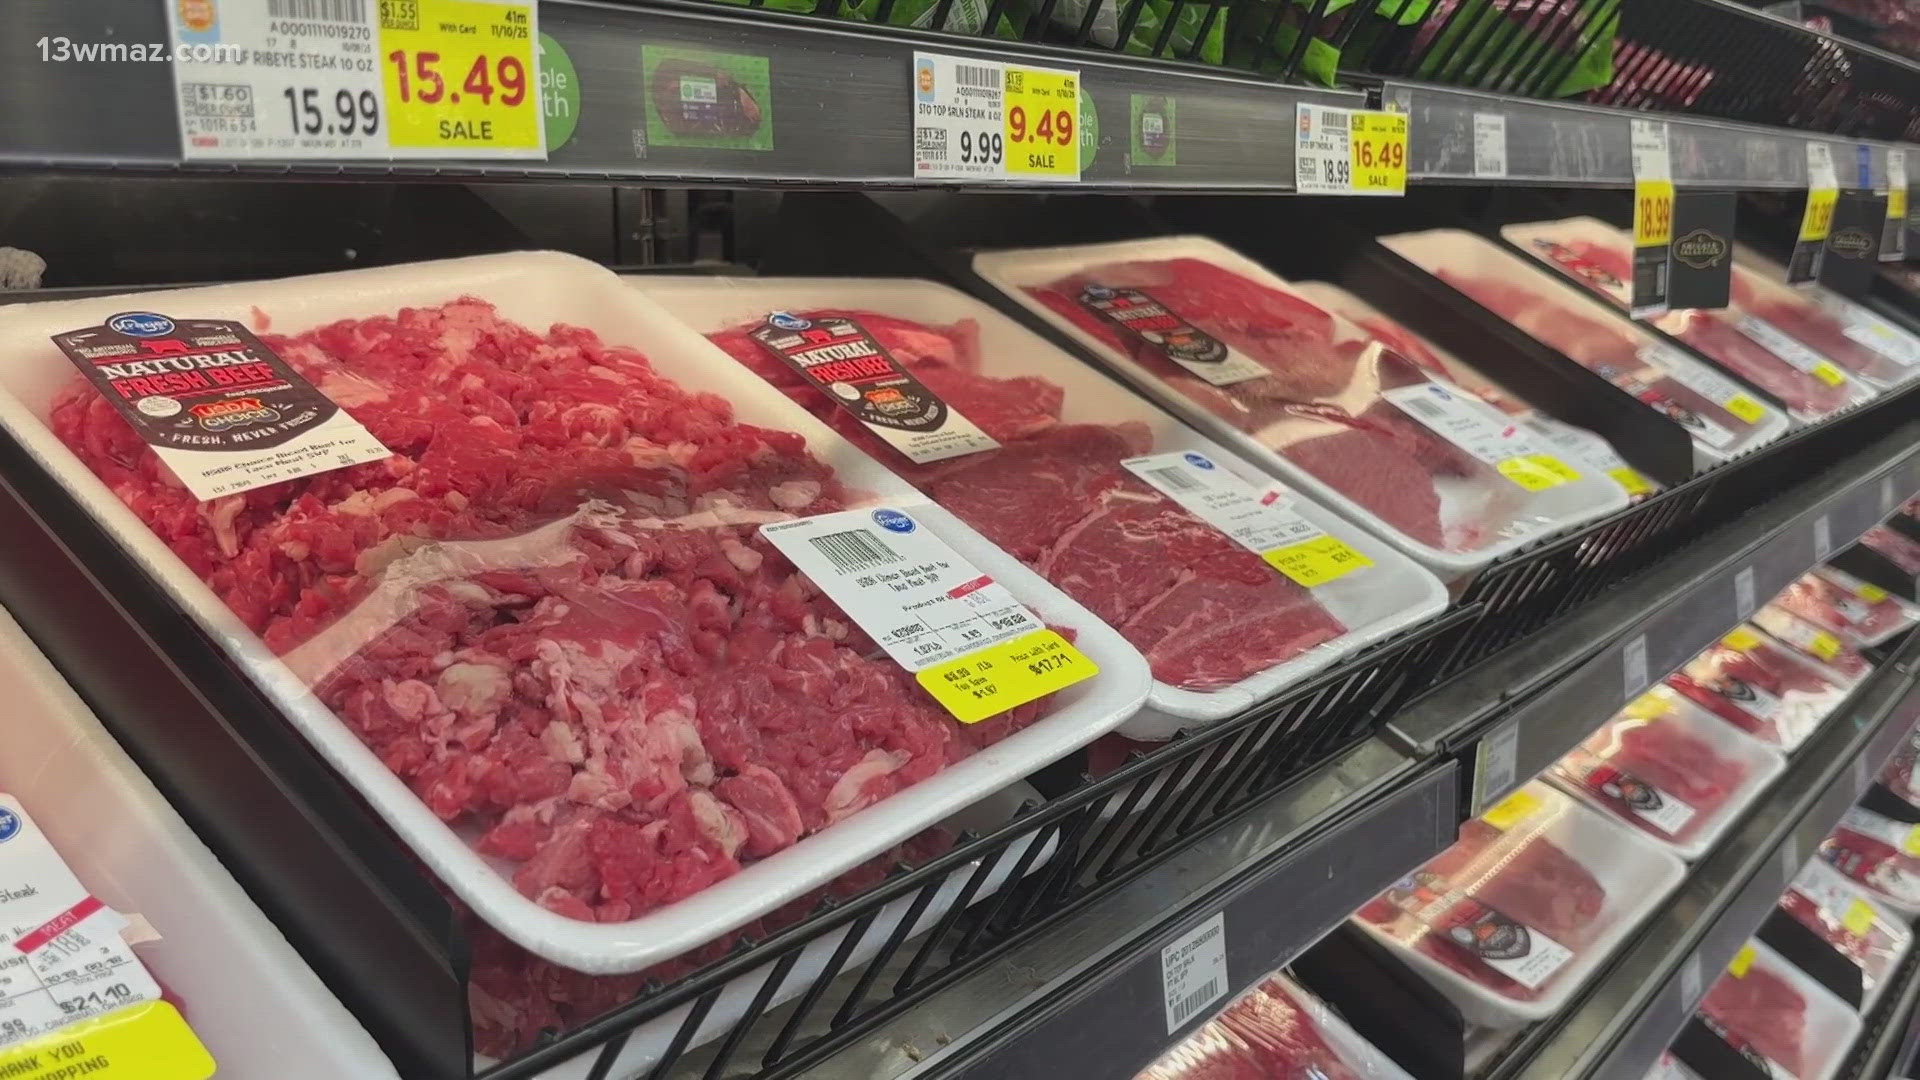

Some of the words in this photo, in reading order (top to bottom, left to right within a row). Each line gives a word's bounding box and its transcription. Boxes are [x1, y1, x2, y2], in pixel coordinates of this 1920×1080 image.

[381, 2, 416, 19] $1.55
[505, 10, 527, 24] 41m
[440, 23, 458, 33] With
[459, 24, 476, 34] Card
[491, 25, 528, 39] 11/10/25
[253, 51, 296, 68] RIBEYE
[299, 53, 337, 69] STEAK
[340, 58, 353, 70] 10
[356, 58, 374, 72] OZ
[389, 49, 526, 107] 15.49
[199, 87, 248, 102] $1.60
[284, 87, 379, 136] 15.99
[919, 104, 931, 115] STO
[933, 105, 946, 116] TOP
[966, 107, 985, 119] STEAK
[439, 120, 493, 140] SALE
[1009, 106, 1072, 146] 9.49
[961, 131, 1002, 164] 9.99
[1354, 140, 1403, 168] 16.49
[1028, 154, 1055, 168] SALE
[1323, 159, 1349, 184] 18.99
[1369, 175, 1388, 186] SALE
[1640, 198, 1670, 239] 18.99
[789, 341, 878, 368] NATURAL
[97, 351, 262, 380] NATURAL
[807, 361, 863, 384] FRESH
[852, 355, 893, 376] BEEF
[111, 371, 212, 399] FRESH
[205, 362, 273, 387] BEEF
[199, 399, 256, 416] USDA
[205, 408, 270, 427] CHOICE
[172, 433, 226, 445] FRESH,
[232, 427, 279, 443] NEVER
[40, 911, 77, 936] MEAT
[60, 983, 131, 1013] $21.10
[48, 1041, 85, 1062] YOU
